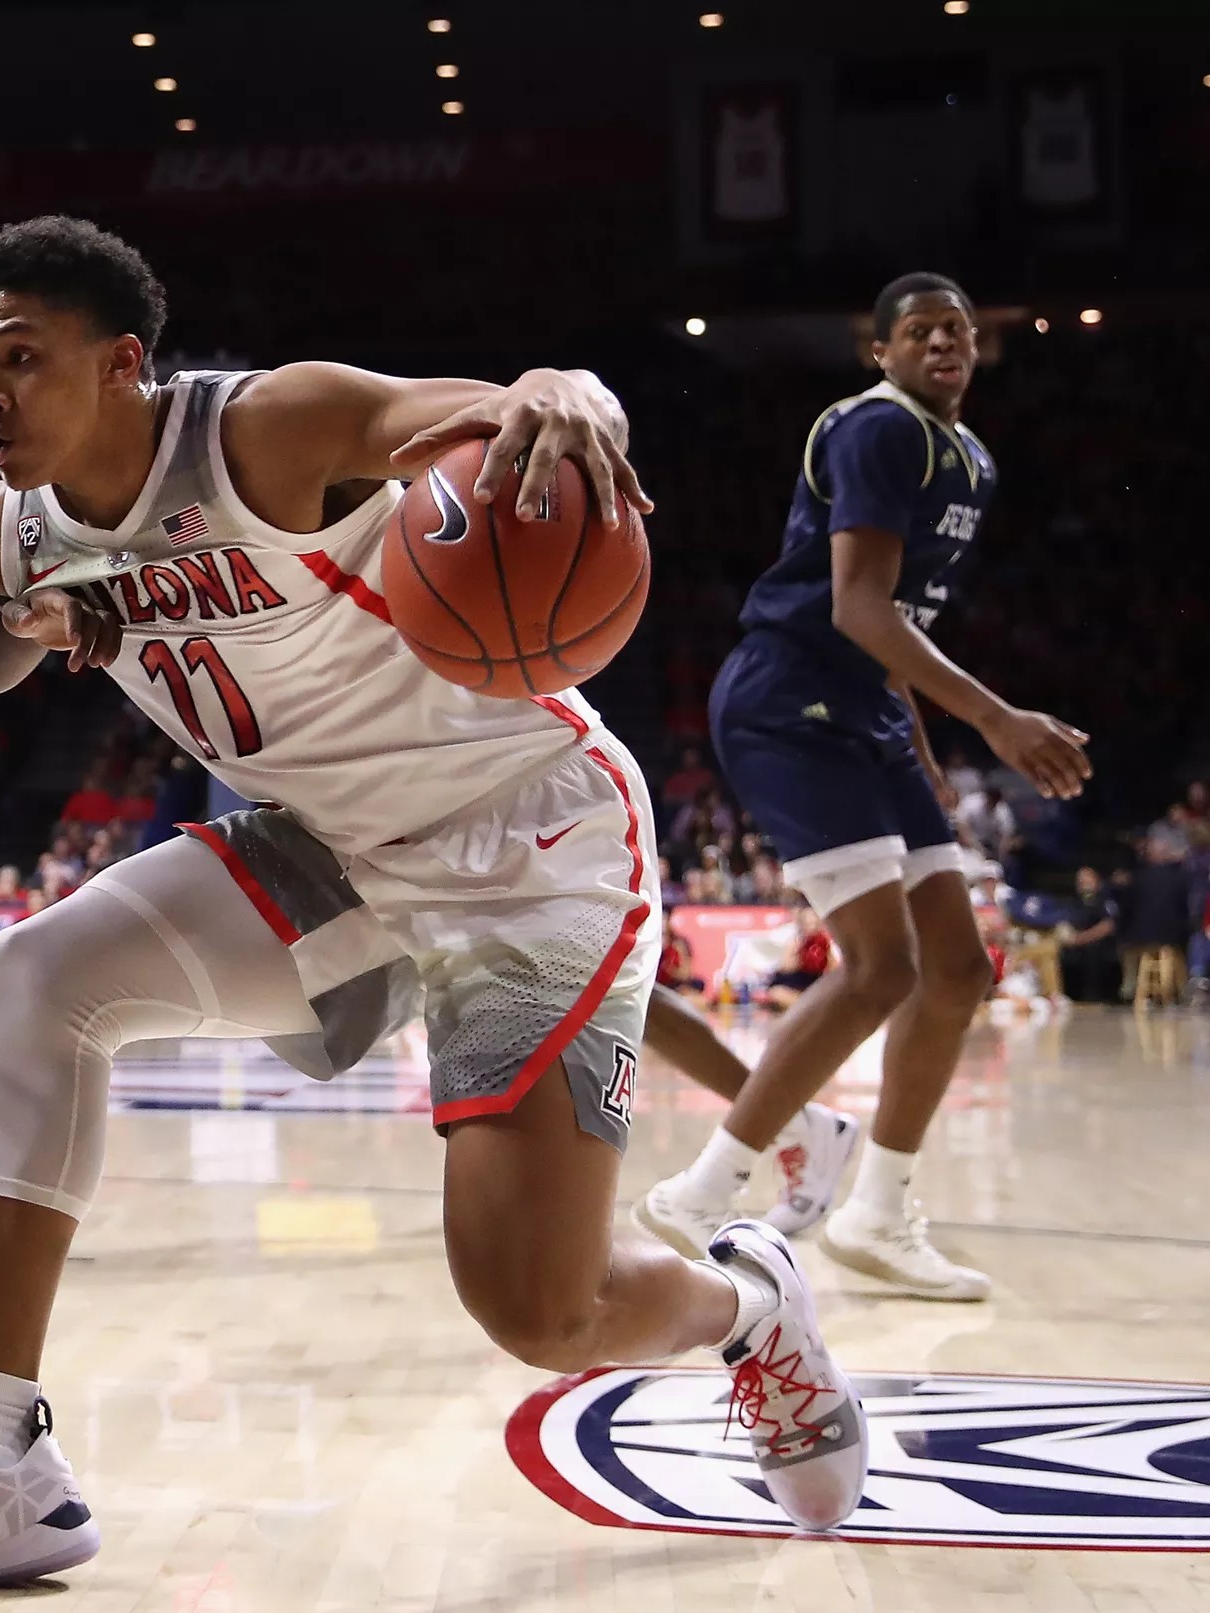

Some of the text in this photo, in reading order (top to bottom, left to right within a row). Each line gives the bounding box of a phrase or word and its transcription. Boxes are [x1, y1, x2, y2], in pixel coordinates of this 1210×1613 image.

[18, 517, 41, 540] PAC
[23, 531, 37, 547] 12
[138, 635, 263, 760] 11
[600, 1041, 638, 1128] A
